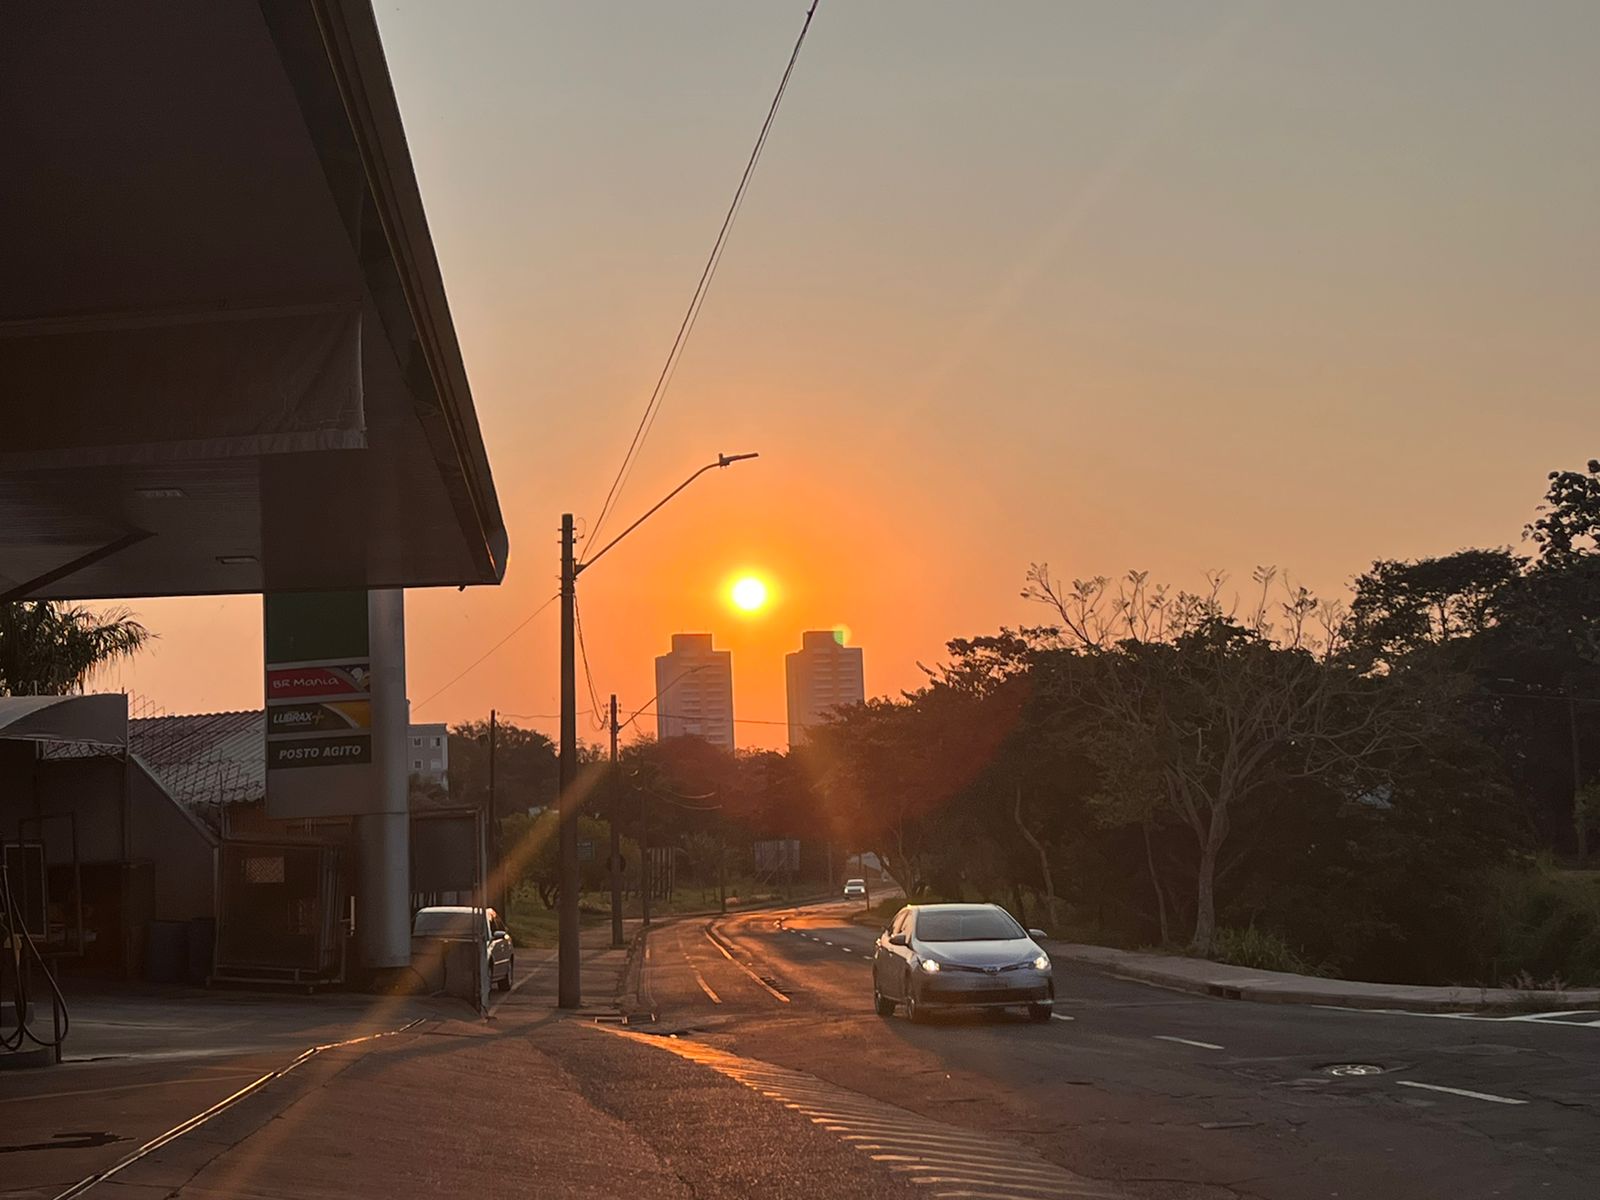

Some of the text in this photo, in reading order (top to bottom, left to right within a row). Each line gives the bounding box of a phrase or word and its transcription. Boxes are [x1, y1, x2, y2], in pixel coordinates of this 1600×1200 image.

[272, 677, 339, 688] BR Mania
[279, 745, 361, 760] POSTO AGITO
